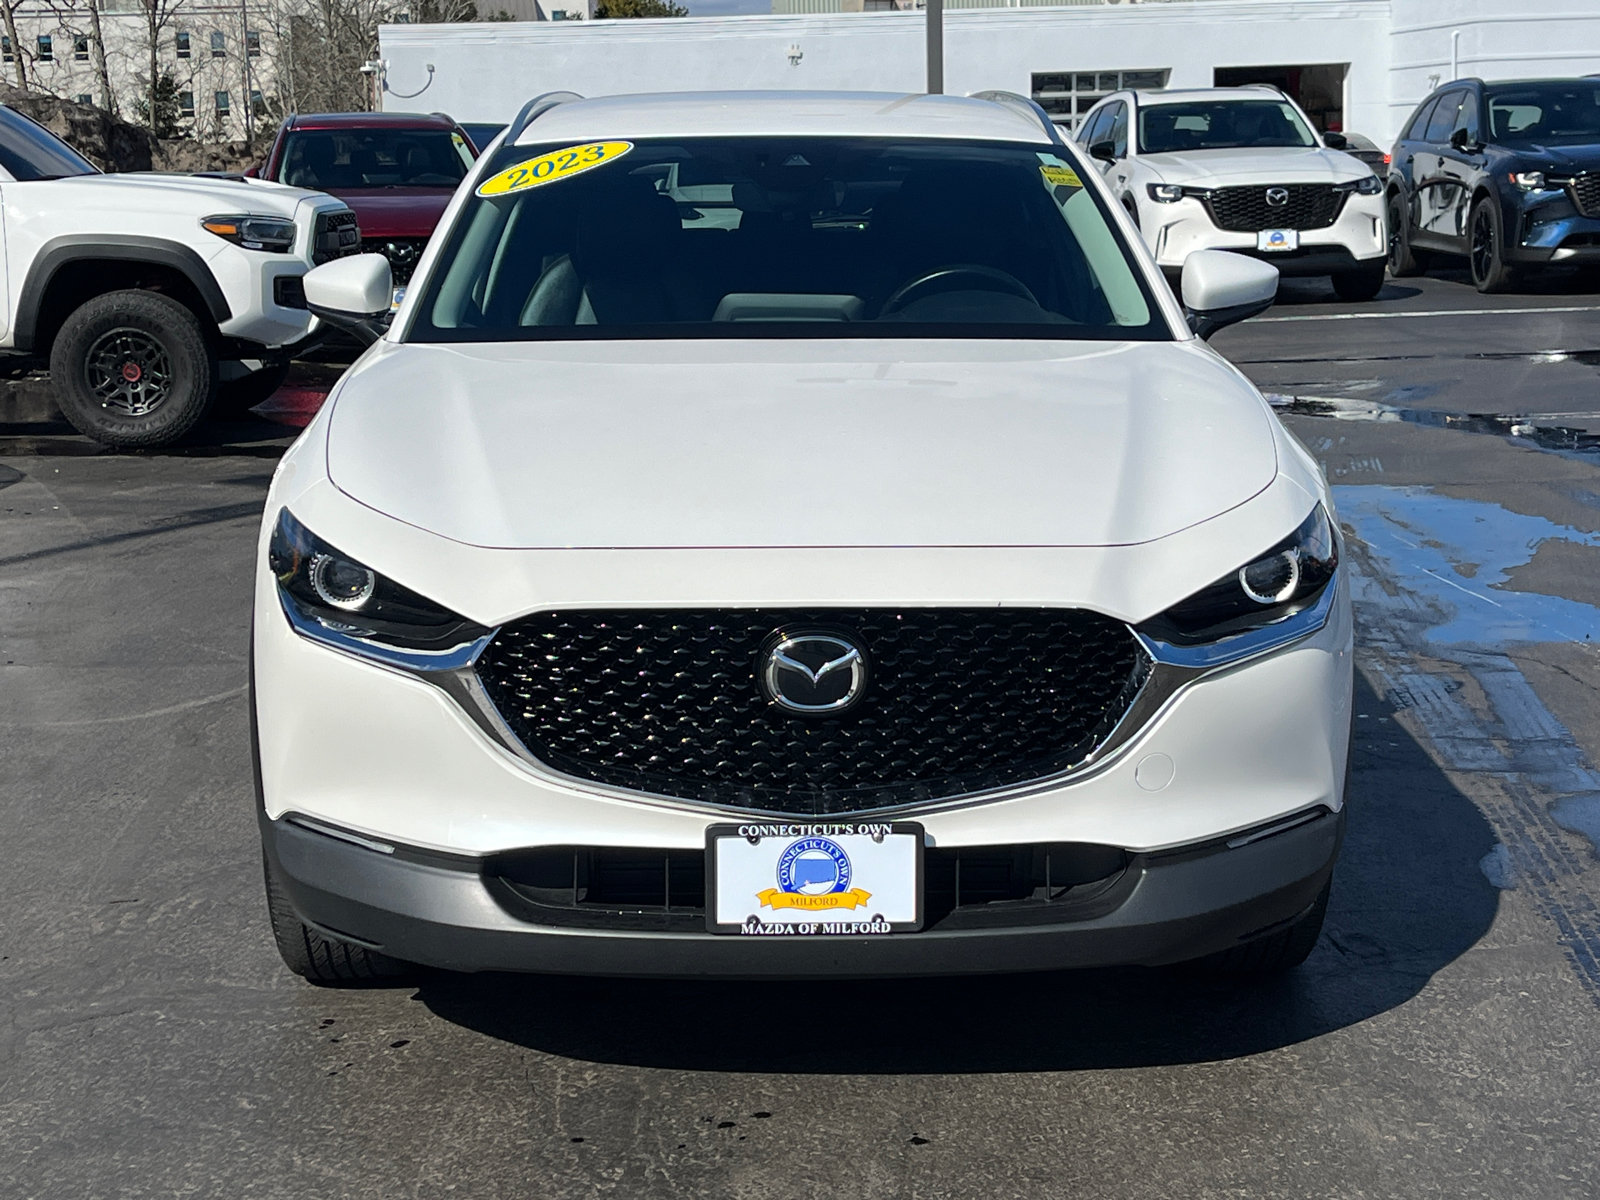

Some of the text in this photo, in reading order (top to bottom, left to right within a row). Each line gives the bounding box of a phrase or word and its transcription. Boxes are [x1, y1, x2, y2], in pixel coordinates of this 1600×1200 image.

[508, 145, 605, 189] 2023
[738, 823, 892, 836] CONNECTICUT'S OWN
[838, 858, 849, 886] OWN
[790, 897, 838, 906] MILFORD
[741, 921, 891, 934] MAZDA OF MILFORD
